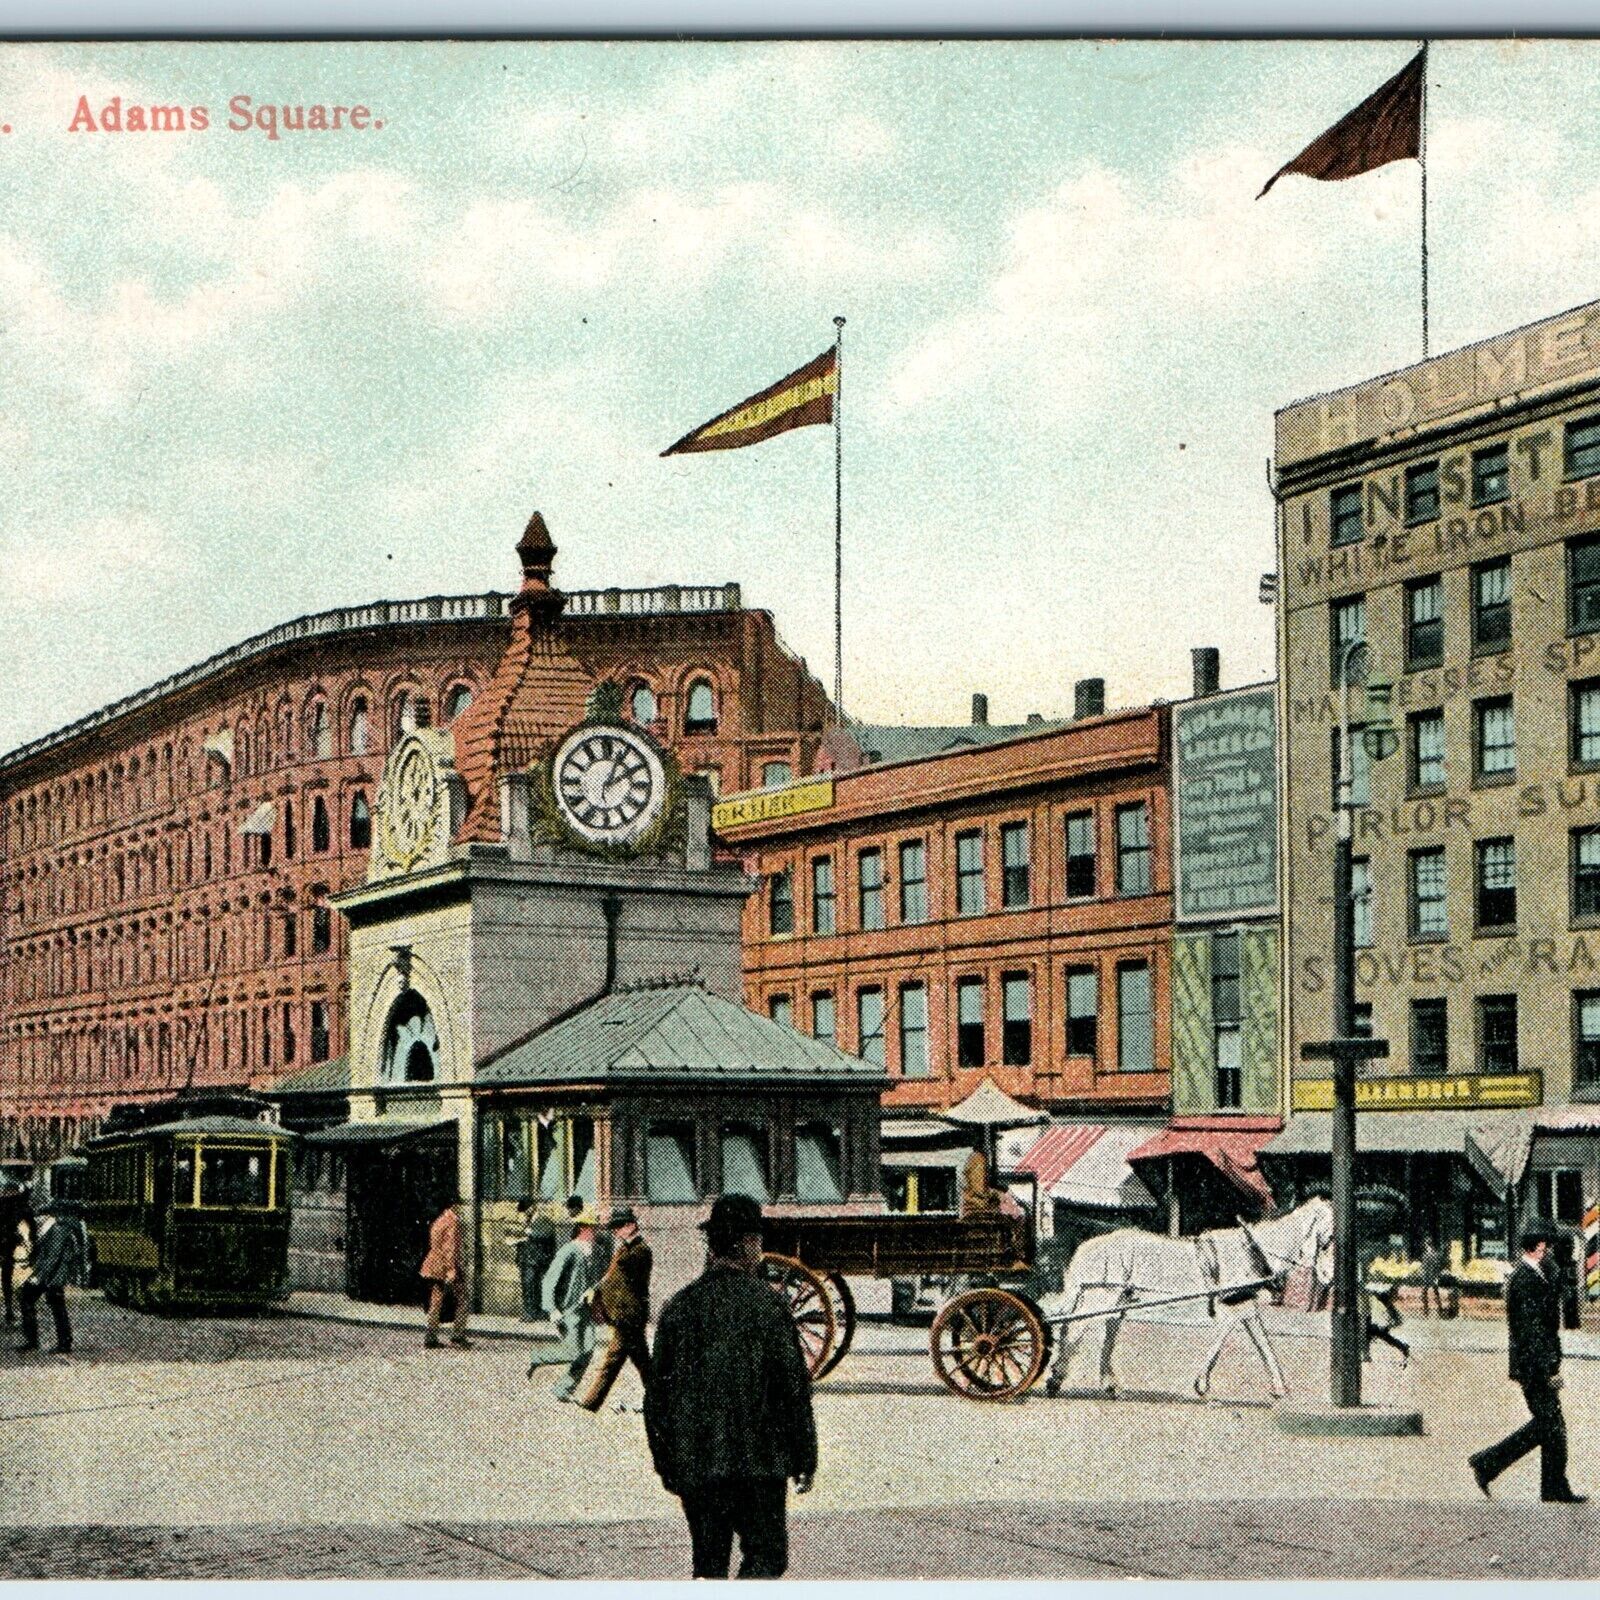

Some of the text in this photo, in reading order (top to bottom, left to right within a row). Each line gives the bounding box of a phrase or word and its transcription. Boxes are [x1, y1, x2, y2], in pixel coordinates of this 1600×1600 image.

[1297, 531, 1412, 586] WHITE
[1434, 504, 1526, 553] IRON
[1306, 799, 1473, 850] PRLOR
[1301, 945, 1464, 993] SOVES
